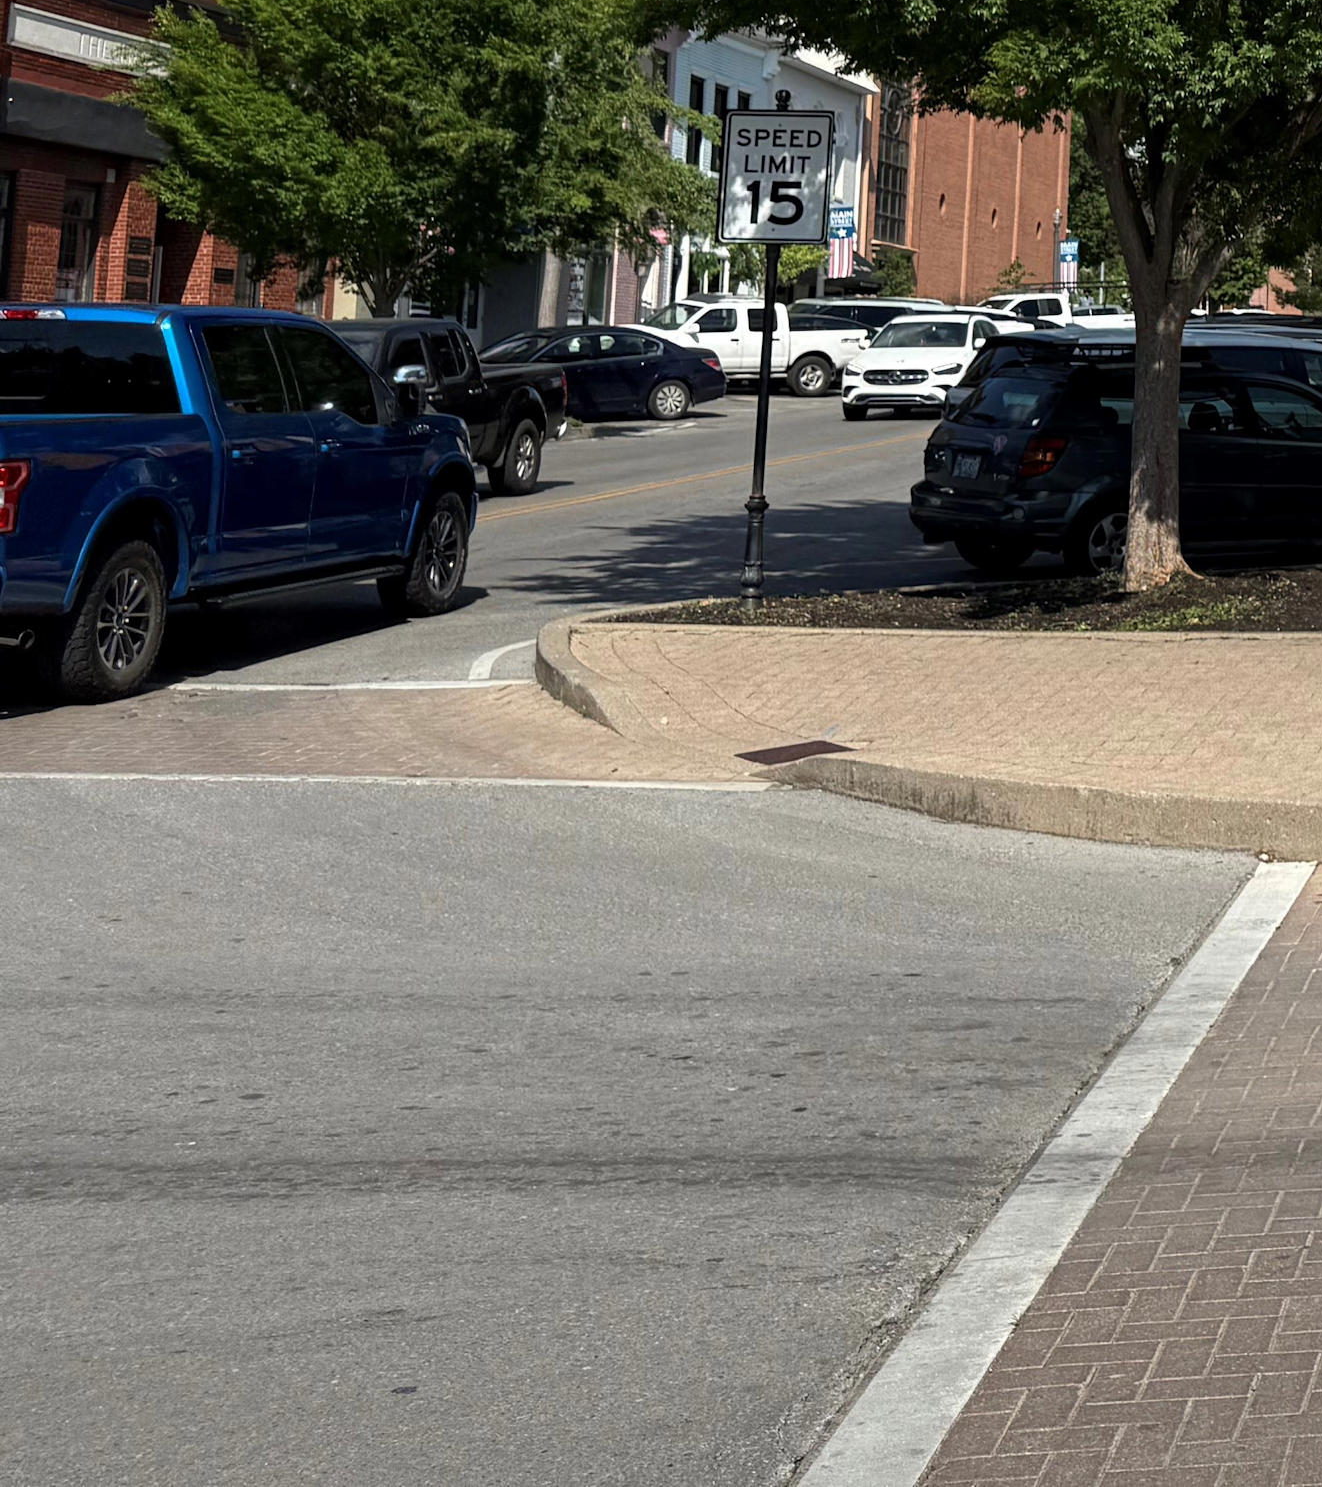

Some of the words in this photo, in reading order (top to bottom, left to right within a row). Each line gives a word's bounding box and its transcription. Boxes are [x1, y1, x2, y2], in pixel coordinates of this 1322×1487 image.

[736, 128, 823, 149] SPEED
[743, 154, 812, 175] LIMIT
[746, 180, 805, 226] 15
